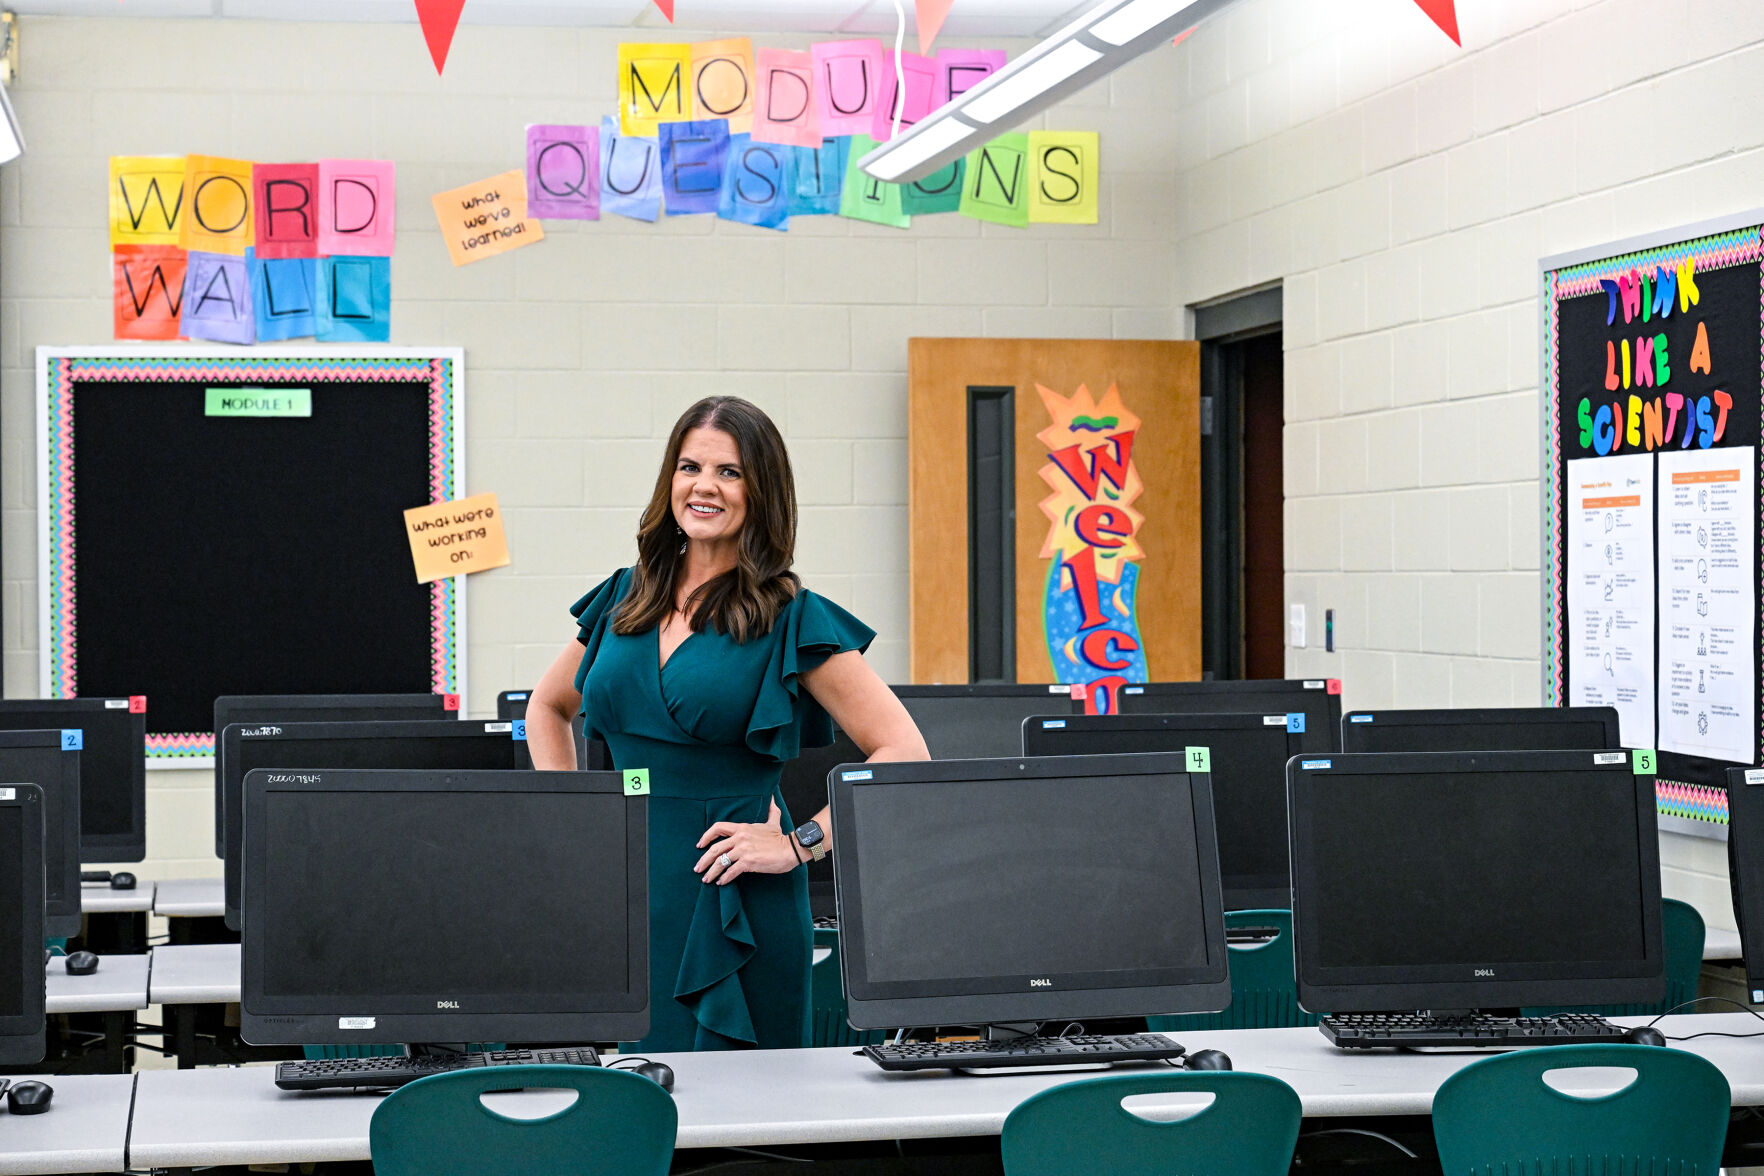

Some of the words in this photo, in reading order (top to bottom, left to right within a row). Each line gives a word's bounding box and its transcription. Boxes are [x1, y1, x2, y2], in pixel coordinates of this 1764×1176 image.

[119, 176, 376, 237] WORD
[123, 263, 371, 319] WALL
[1600, 256, 1700, 326] THINK
[1604, 332, 1671, 391] LIKE
[1690, 321, 1711, 375] A
[221, 398, 282, 410] MODULE
[288, 398, 293, 410] 1
[1577, 389, 1733, 456] SCIENTIST
[412, 516, 451, 532] what
[428, 527, 486, 547] working
[448, 698, 456, 707] 3
[1292, 718, 1300, 729] 5
[517, 725, 526, 737] 3
[67, 735, 77, 746] 2
[1192, 752, 1204, 768] 4
[1641, 755, 1650, 770] 5
[631, 776, 642, 790] 3
[1474, 969, 1495, 977] DELL
[1030, 979, 1052, 987] DELL
[437, 1000, 460, 1009] DELL
